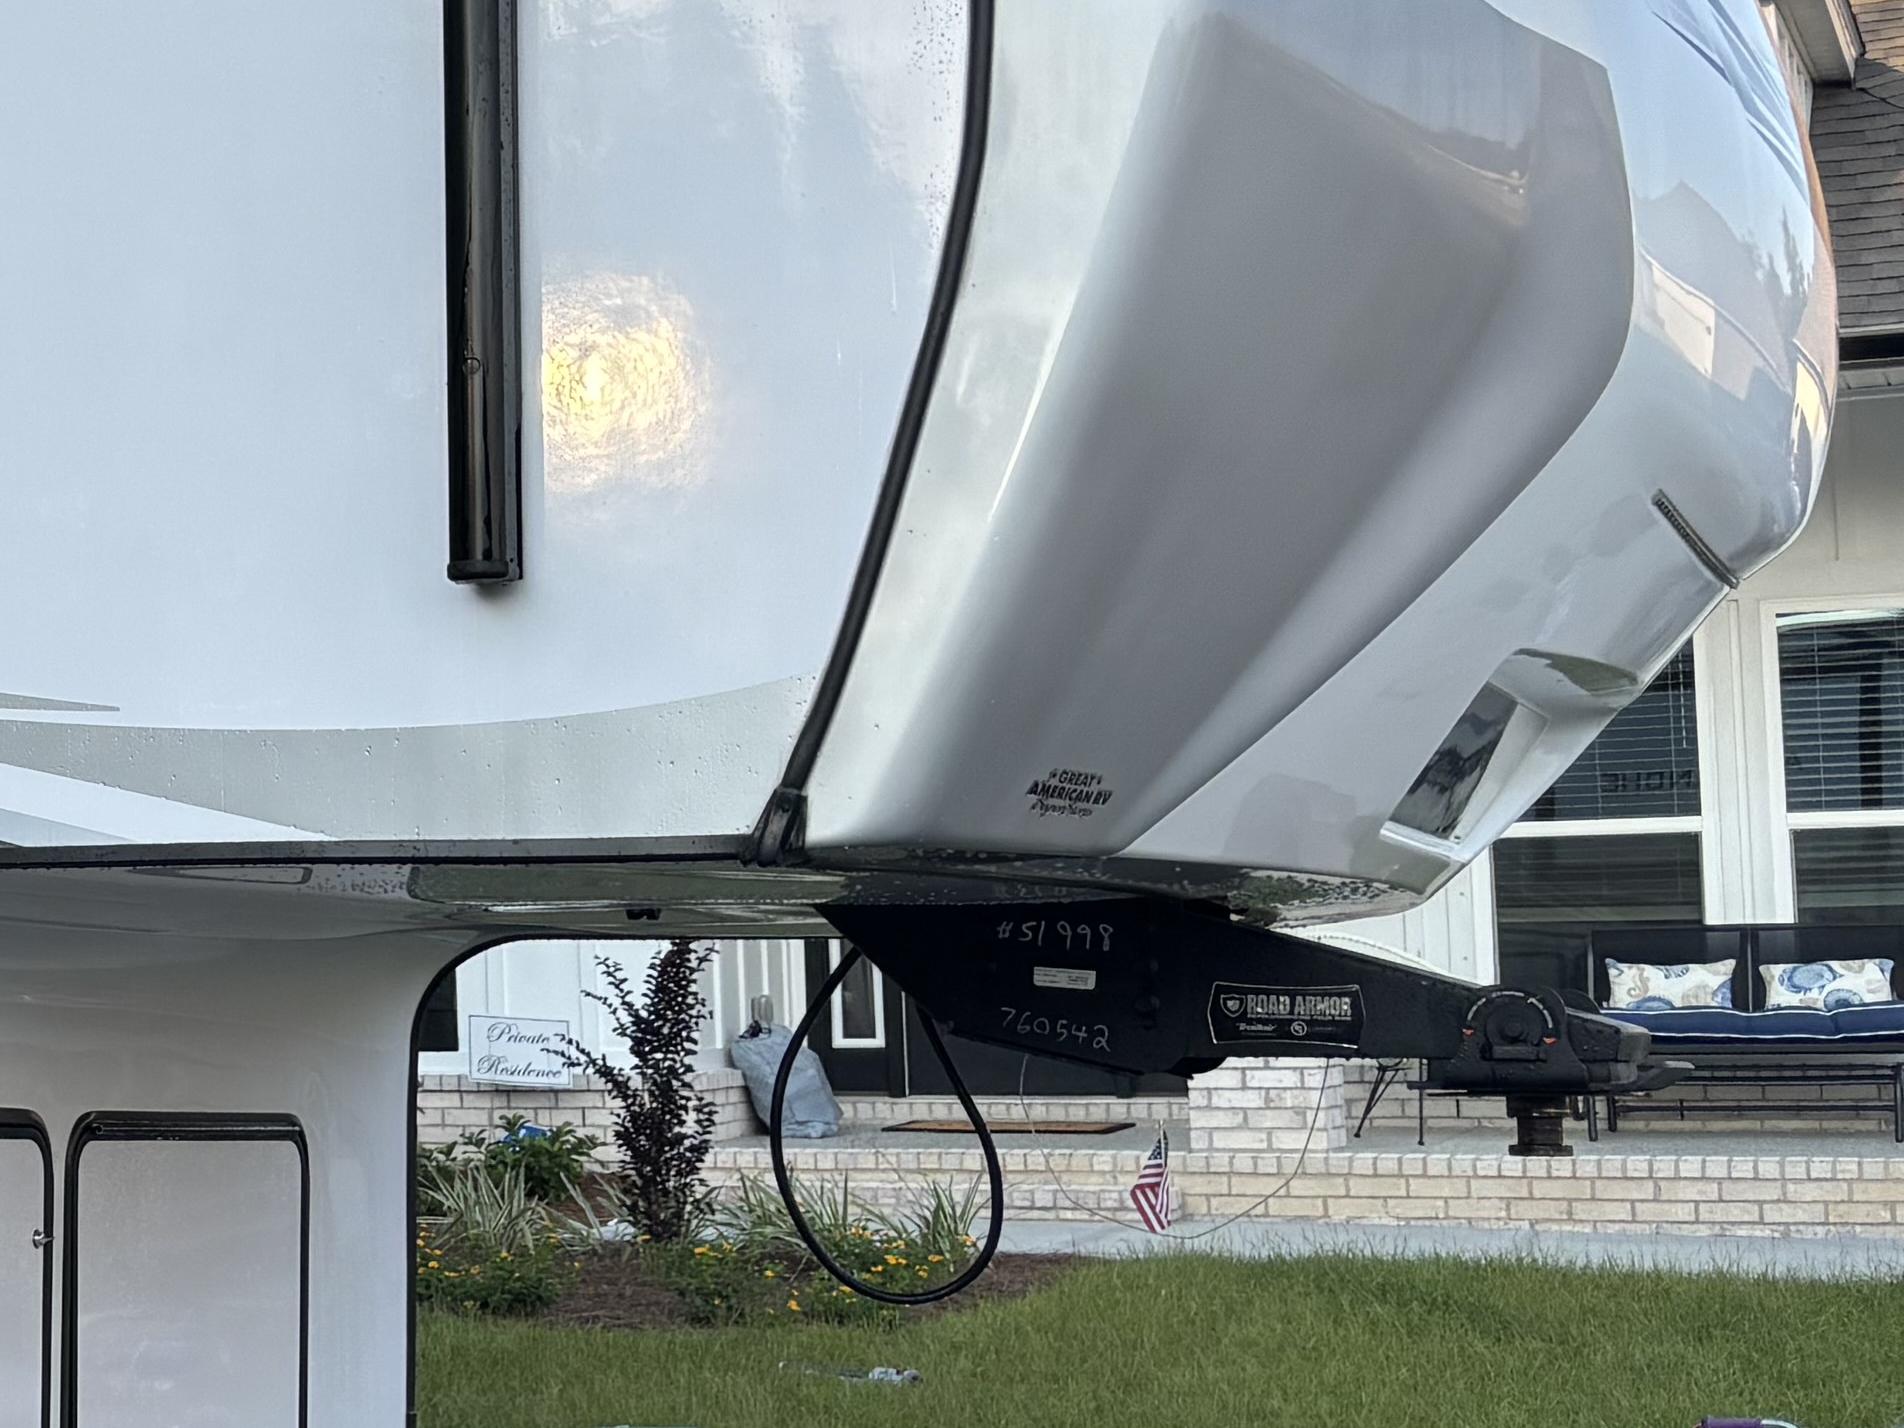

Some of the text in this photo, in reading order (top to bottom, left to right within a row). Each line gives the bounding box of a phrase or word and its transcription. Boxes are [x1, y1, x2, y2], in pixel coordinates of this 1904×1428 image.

[1058, 769, 1096, 788] GREAT
[1025, 780, 1094, 804] AMERICAN
[1246, 994, 1352, 1016] ROAD ARMOR
[487, 1022, 550, 1044] Private
[1000, 1007, 1112, 1053] 760542
[477, 1055, 562, 1079] Residence
